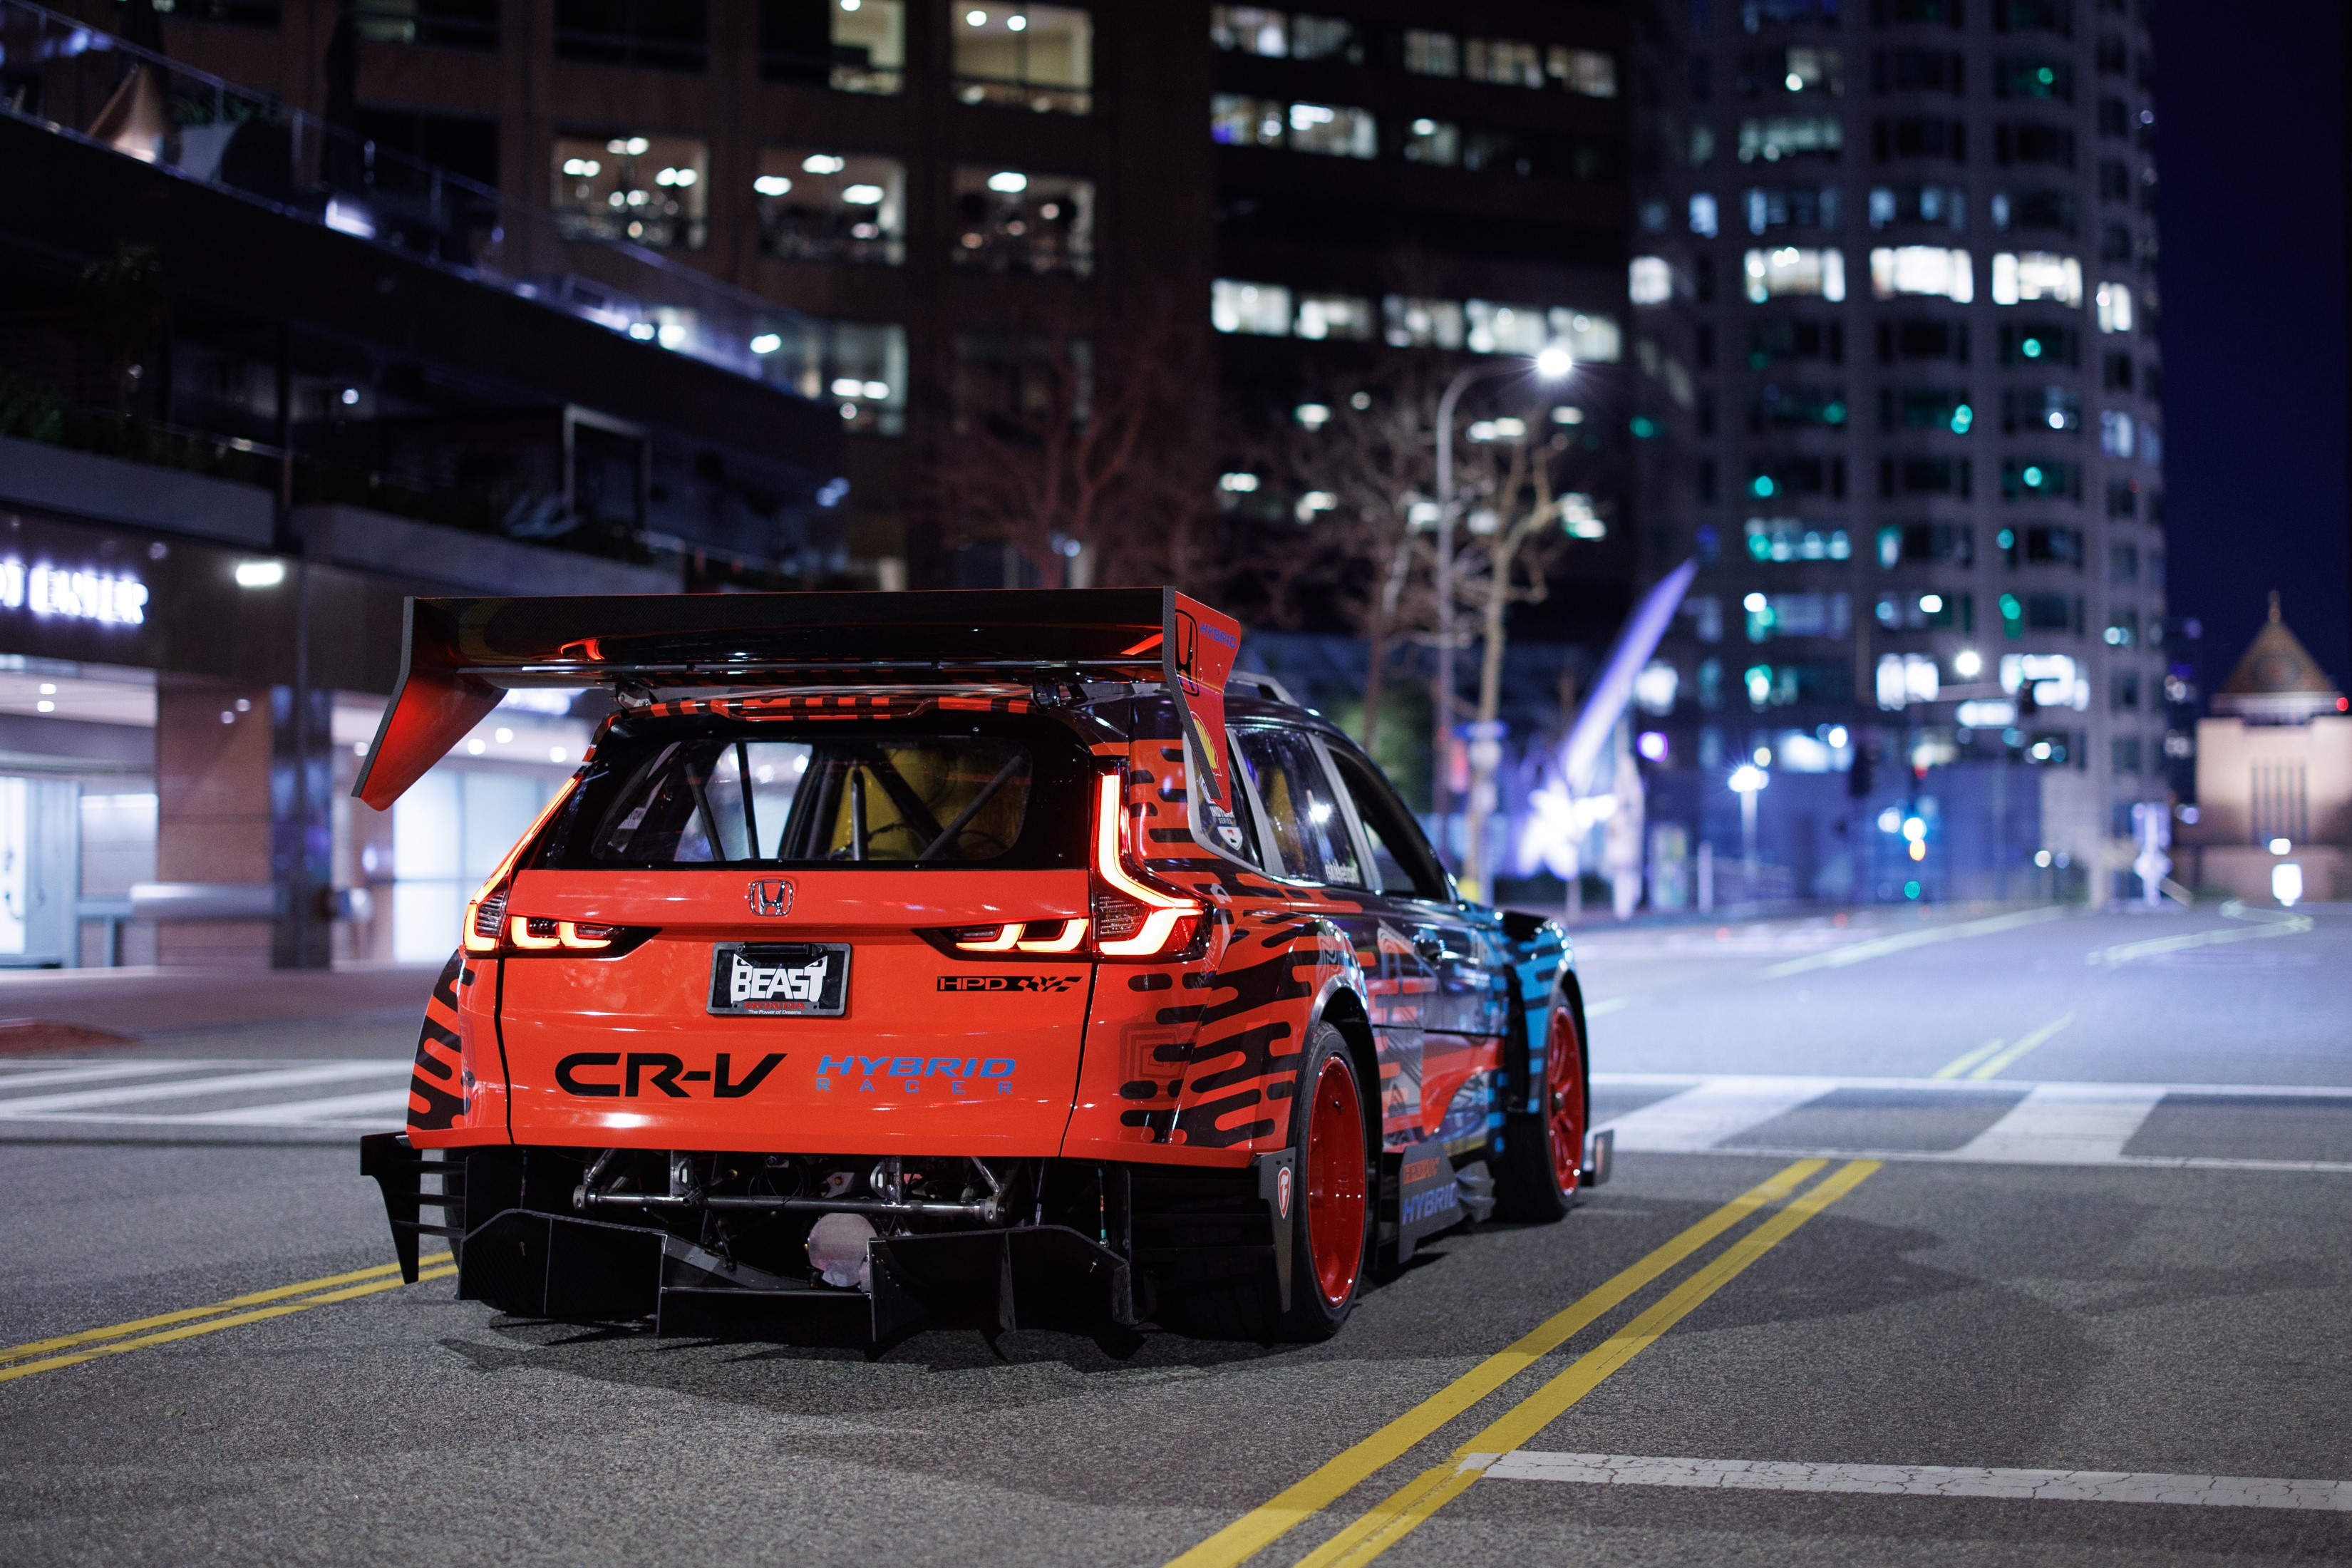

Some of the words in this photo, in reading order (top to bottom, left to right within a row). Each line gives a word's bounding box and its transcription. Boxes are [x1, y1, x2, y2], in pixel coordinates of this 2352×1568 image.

[1199, 621, 1237, 649] HYBRID
[730, 953, 828, 1004] BEAST
[939, 977, 1009, 991] HPD
[744, 1001, 807, 1010] HONDA
[555, 1052, 788, 1098] CR-V
[816, 1056, 1016, 1078] HYBRID
[815, 1078, 1013, 1095] RACER
